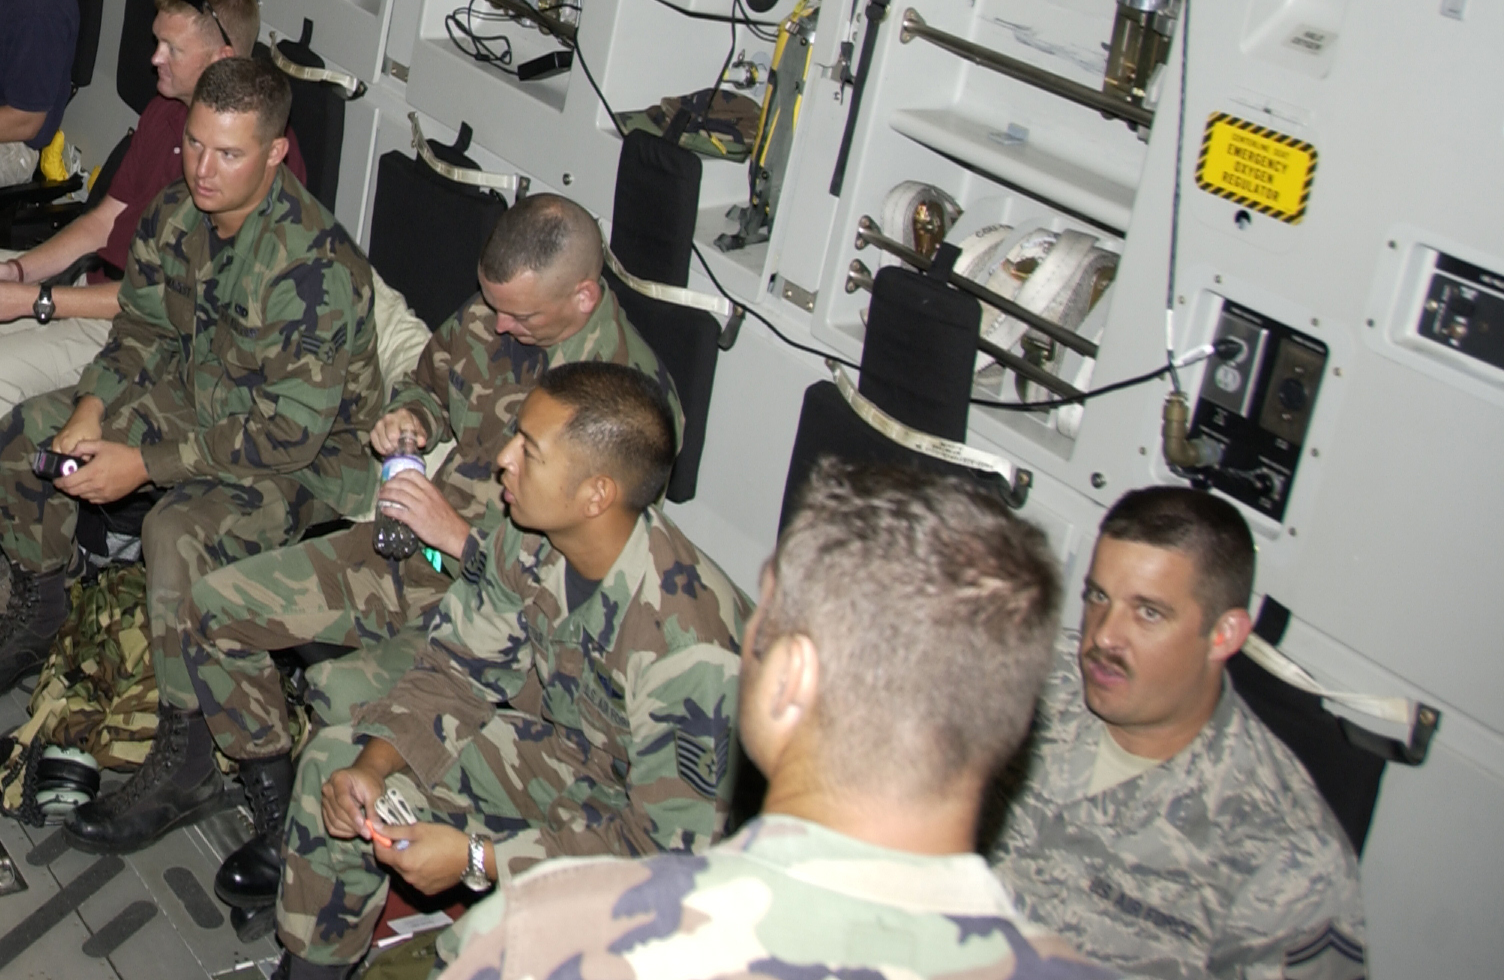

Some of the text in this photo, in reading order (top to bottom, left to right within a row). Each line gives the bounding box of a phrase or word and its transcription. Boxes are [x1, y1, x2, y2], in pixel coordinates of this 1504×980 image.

[1226, 142, 1289, 175] EMERGENCY
[1234, 160, 1274, 185] OXYGEN
[1222, 170, 1281, 203] REGULATOR
